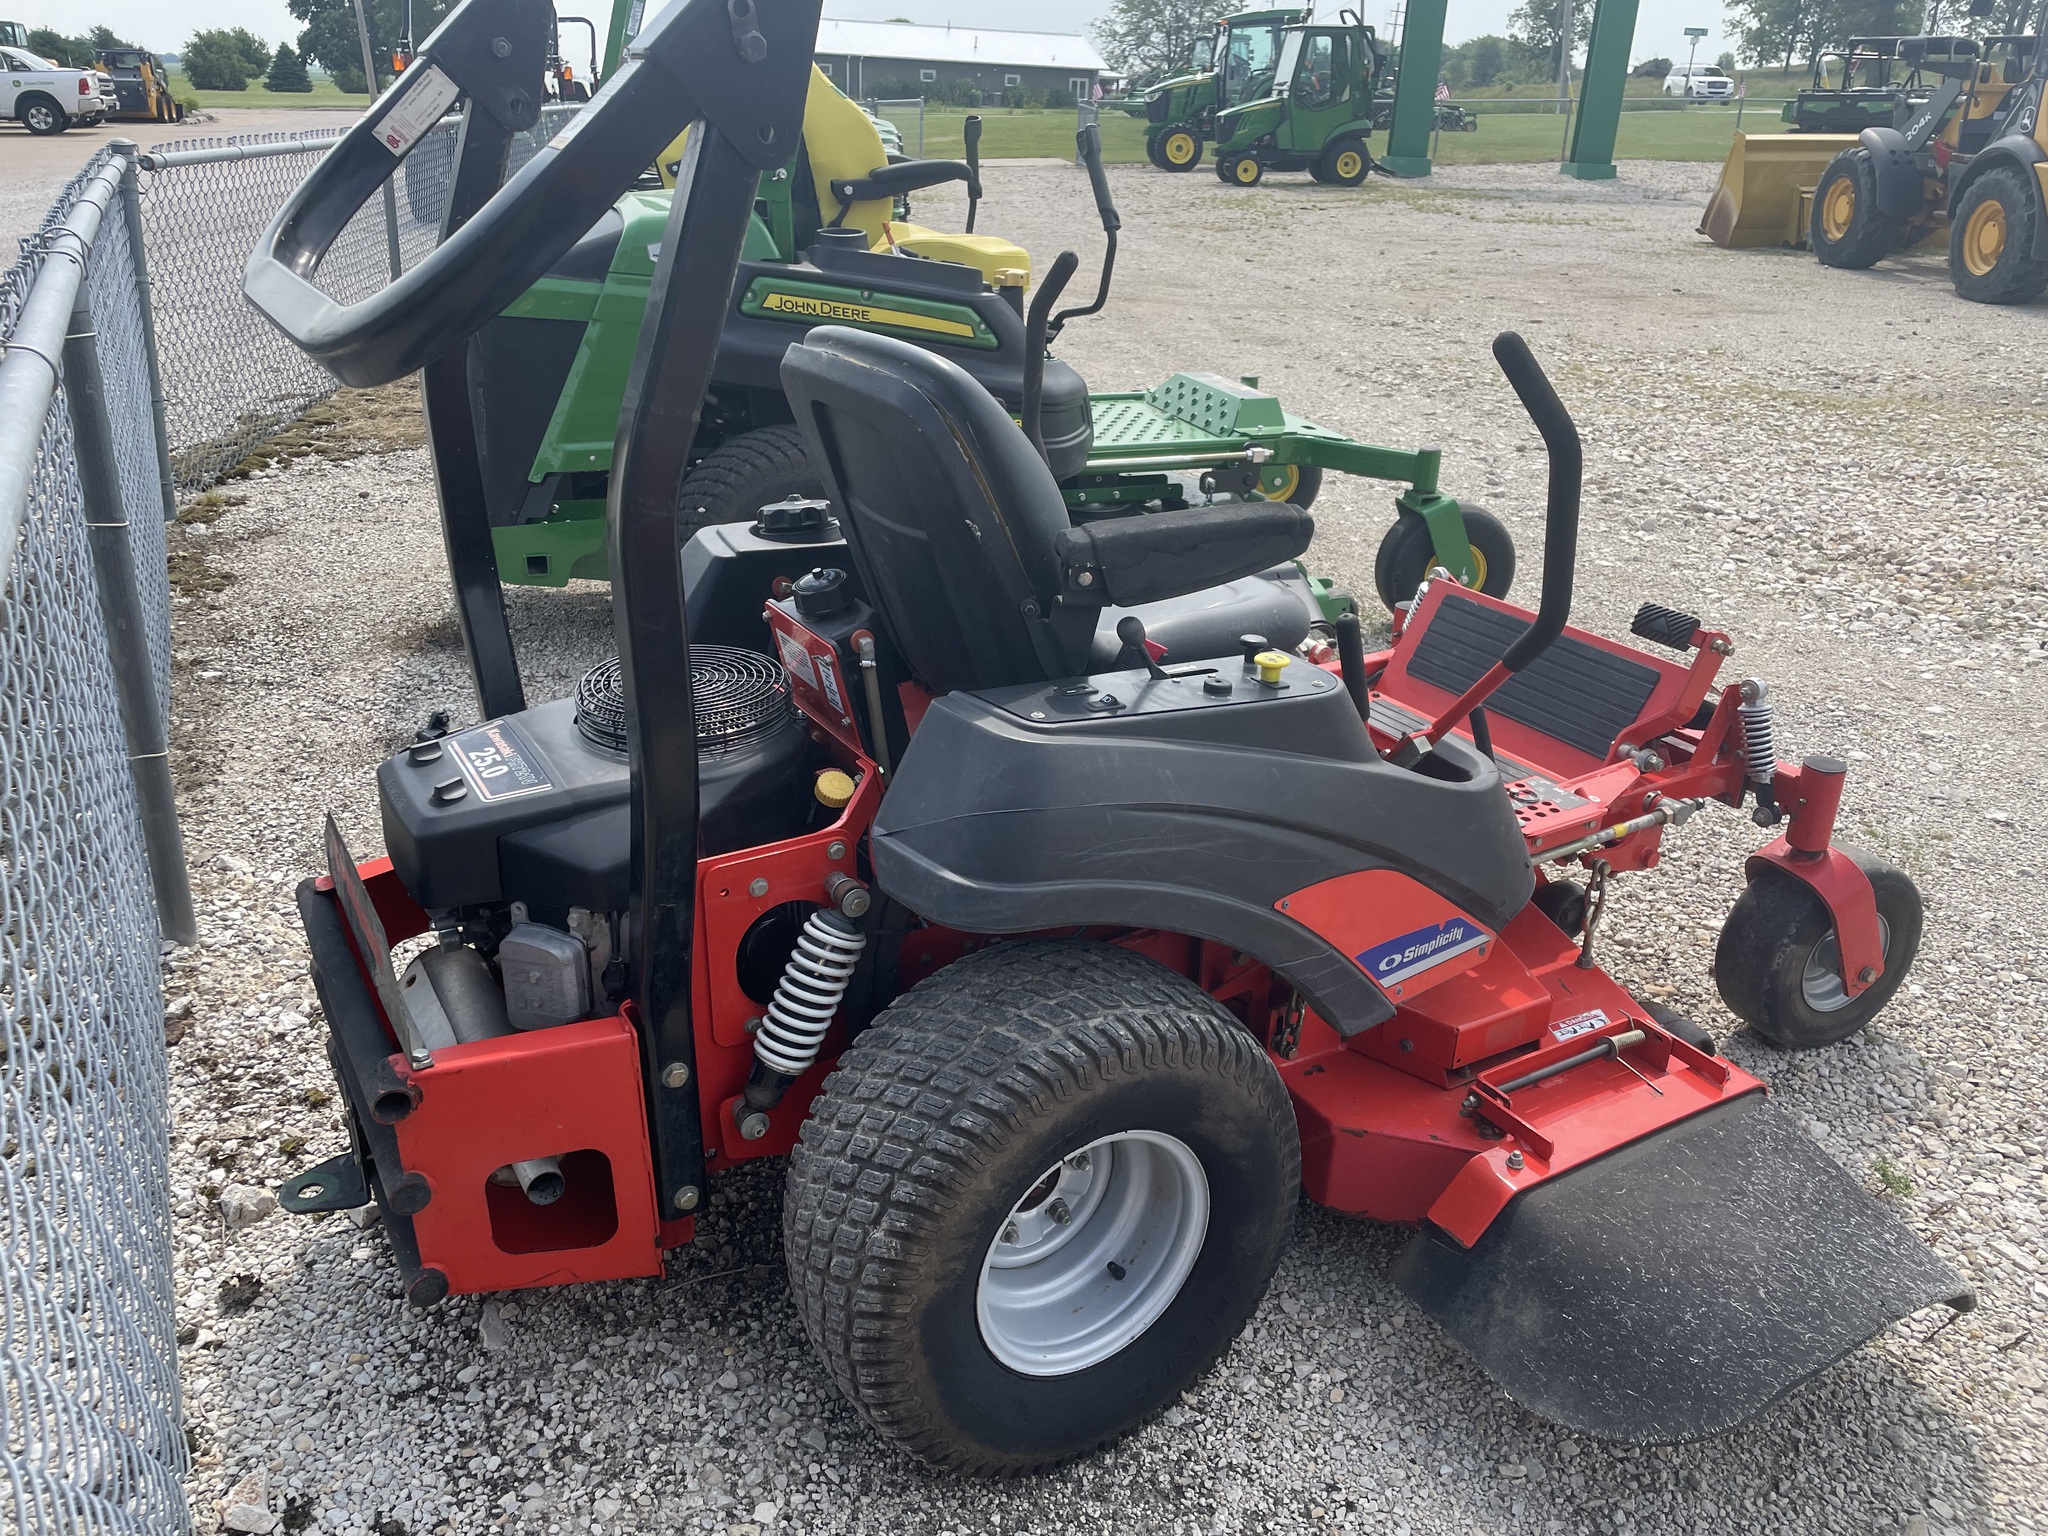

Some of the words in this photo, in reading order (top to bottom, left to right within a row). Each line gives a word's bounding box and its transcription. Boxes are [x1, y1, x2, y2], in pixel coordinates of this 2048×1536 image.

[1905, 112, 1932, 141] 204K
[775, 297, 816, 314] JOHN
[820, 302, 870, 320] DEERE
[485, 728, 516, 758] Kawasaki
[468, 747, 509, 778] 25.0
[1403, 926, 1464, 963] Simplicity
